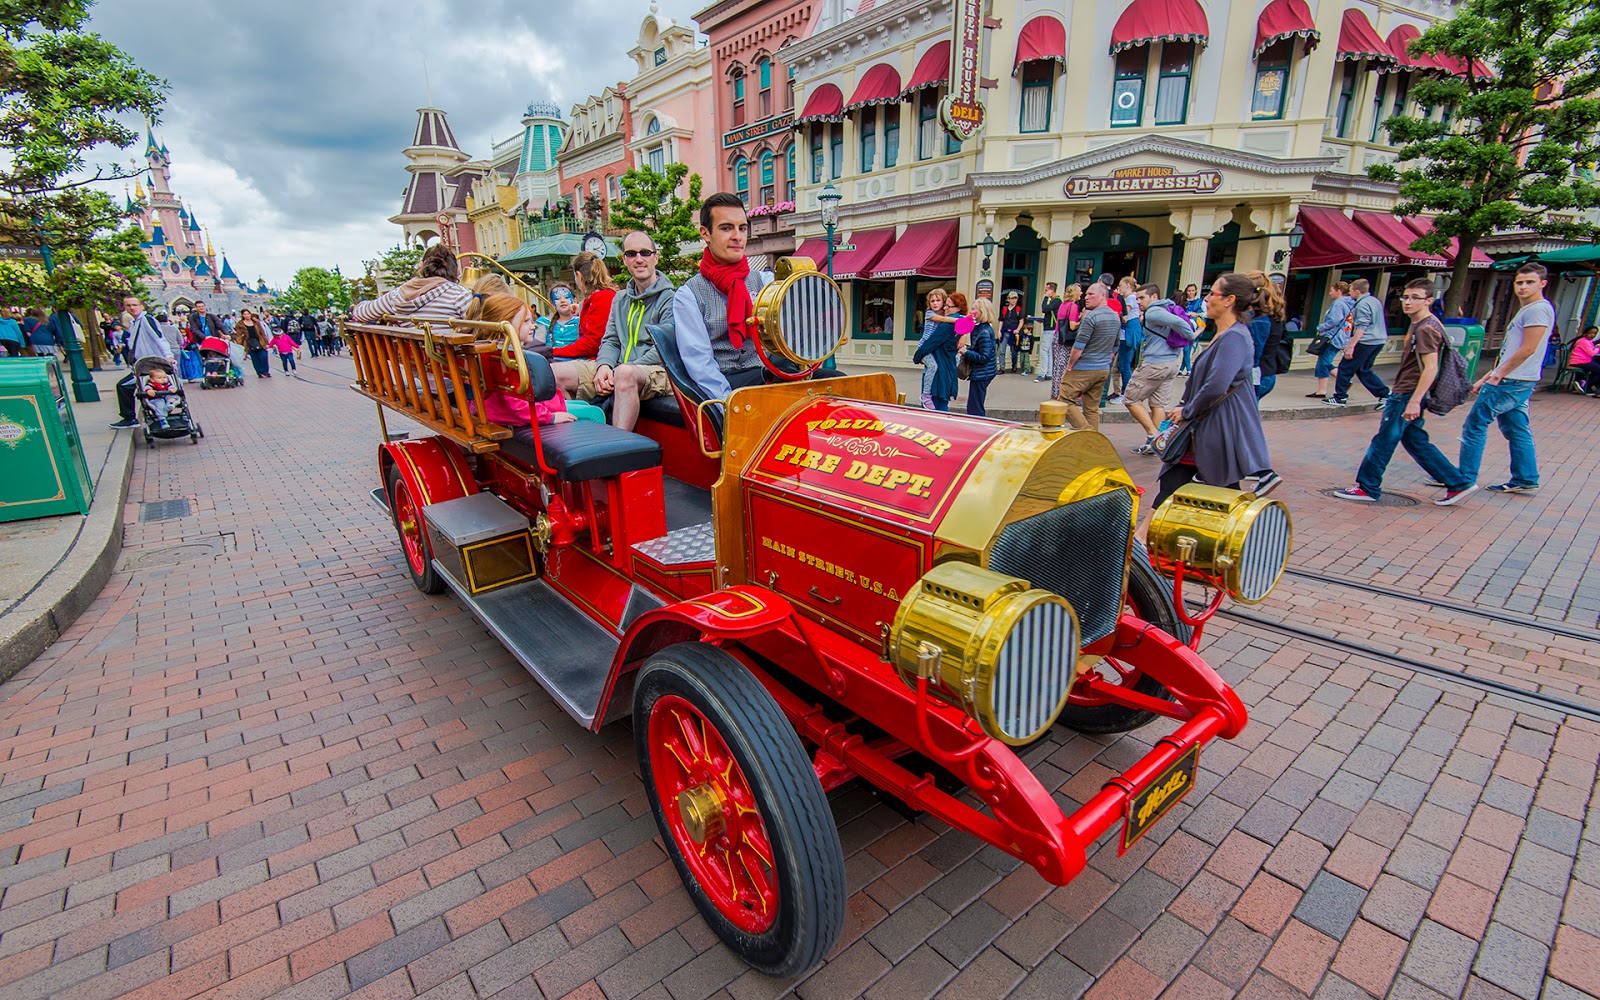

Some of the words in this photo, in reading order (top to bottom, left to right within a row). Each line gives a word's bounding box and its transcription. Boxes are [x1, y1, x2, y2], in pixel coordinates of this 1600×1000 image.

[963, 47, 973, 104] HOUSE
[953, 105, 979, 121] DELI
[727, 130, 744, 144] MAIN
[745, 123, 770, 138] STREET
[1115, 168, 1146, 178] MARKET
[1148, 167, 1172, 177] HOUSE
[1072, 173, 1215, 194] DELICATESSEN
[873, 268, 917, 278] SANDWICHES
[806, 418, 952, 458] VOLUNTEER
[774, 444, 842, 474] FIRE
[844, 459, 935, 500] DEPT.
[762, 536, 796, 558] MAIN
[1137, 769, 1188, 827] Hertz
